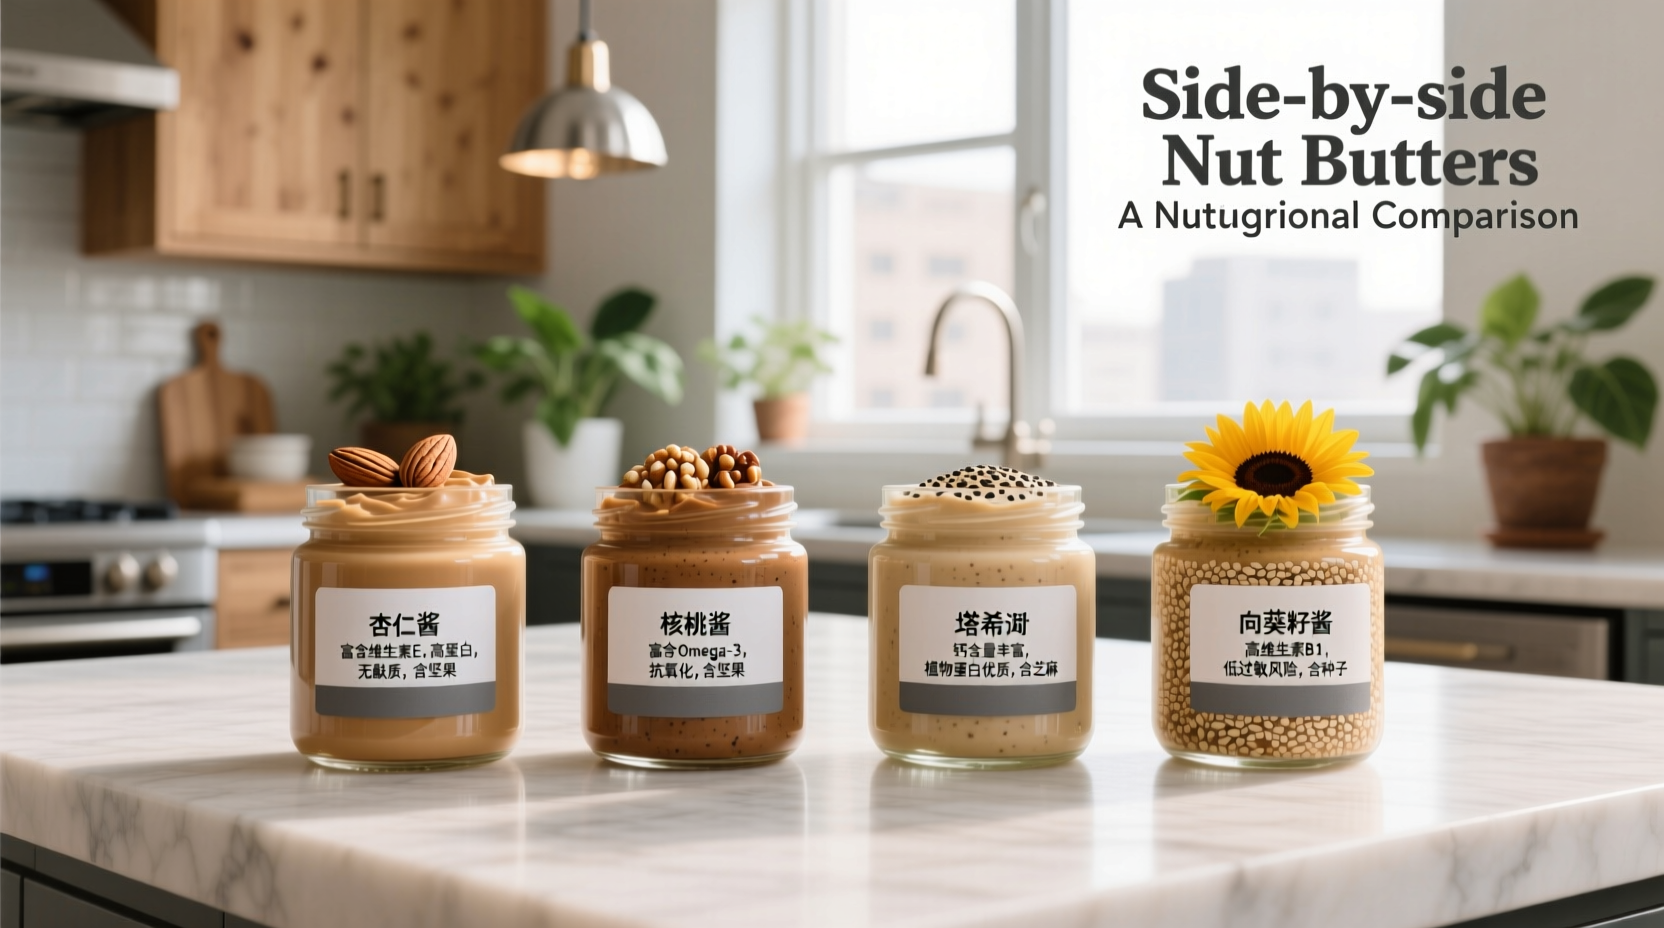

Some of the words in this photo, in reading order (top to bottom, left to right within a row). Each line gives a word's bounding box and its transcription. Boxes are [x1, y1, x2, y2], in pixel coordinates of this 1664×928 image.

[368, 610, 441, 638] 杏仁酱
[659, 610, 732, 637] 核桃酱
